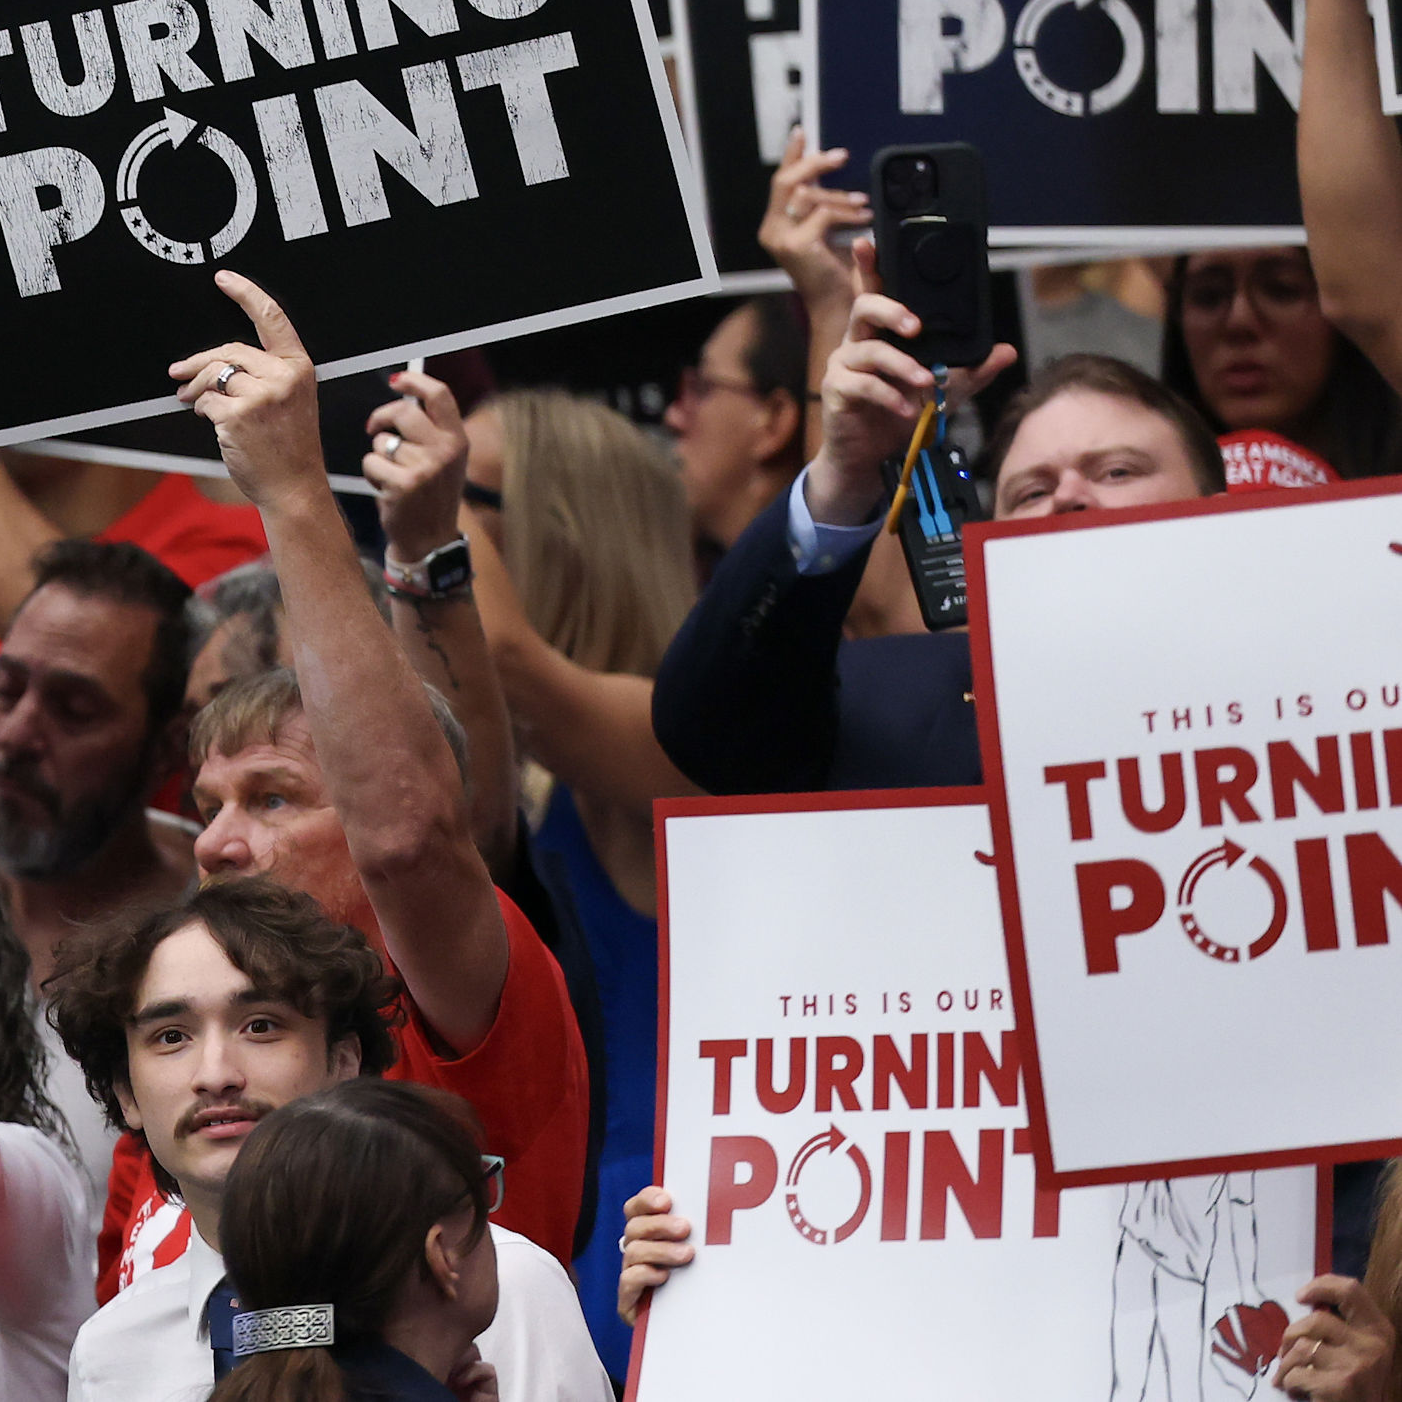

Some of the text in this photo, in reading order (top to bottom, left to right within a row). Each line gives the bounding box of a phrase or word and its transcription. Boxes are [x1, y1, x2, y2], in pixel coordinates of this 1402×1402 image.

[1226, 460, 1264, 486] EAT
[1142, 683, 1400, 733] THIS IS OU
[1044, 726, 1402, 842] TURNI
[1074, 832, 1402, 976] POIN
[780, 988, 1004, 1018] THIS IS OUR
[699, 1030, 1020, 1116] TURNIN
